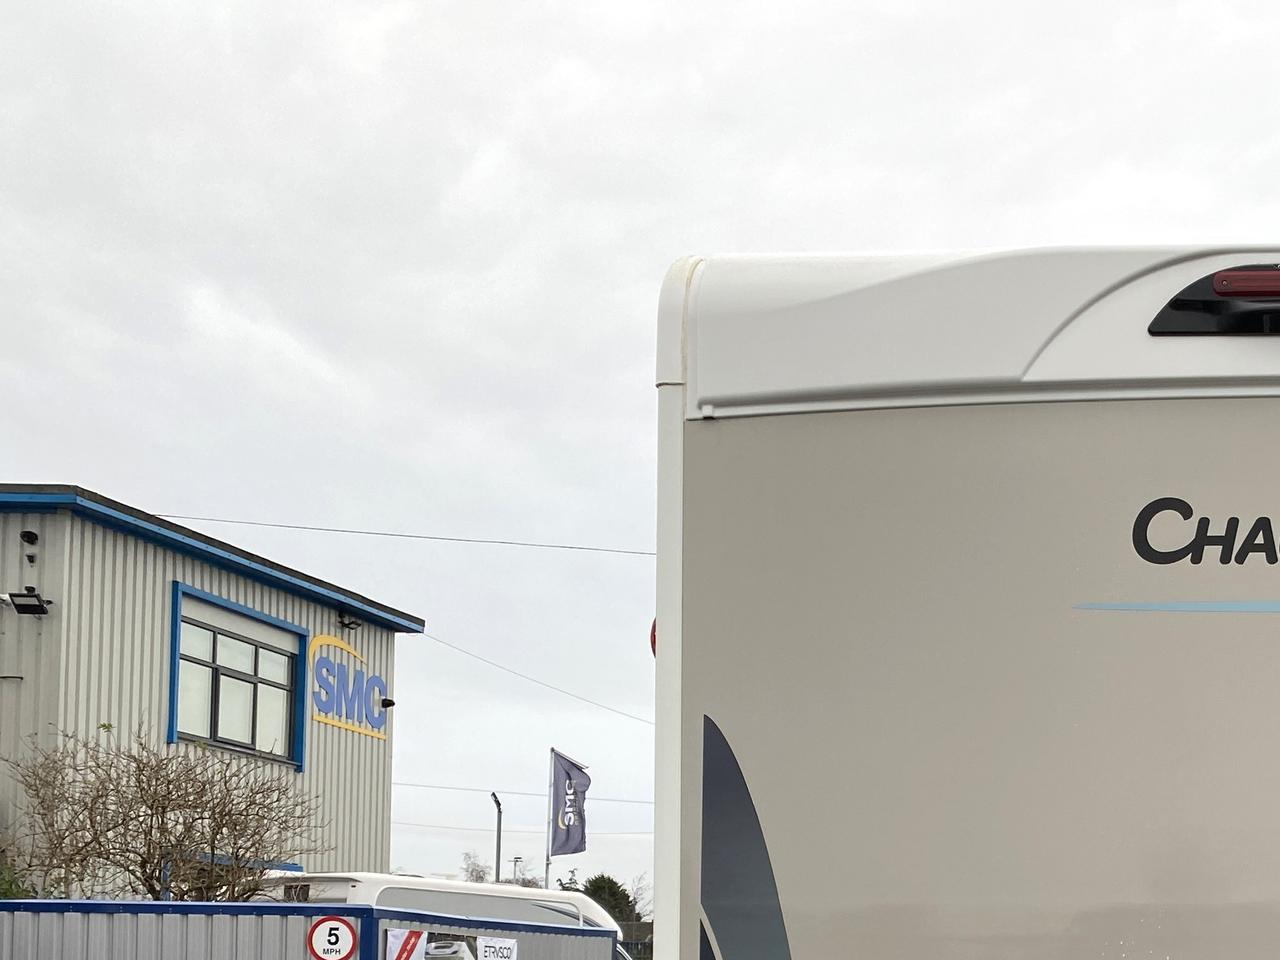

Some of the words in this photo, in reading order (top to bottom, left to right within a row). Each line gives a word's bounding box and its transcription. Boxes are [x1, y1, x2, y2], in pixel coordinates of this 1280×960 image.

[313, 656, 387, 729] SMC
[565, 779, 574, 826] SMC
[327, 927, 339, 946] 5
